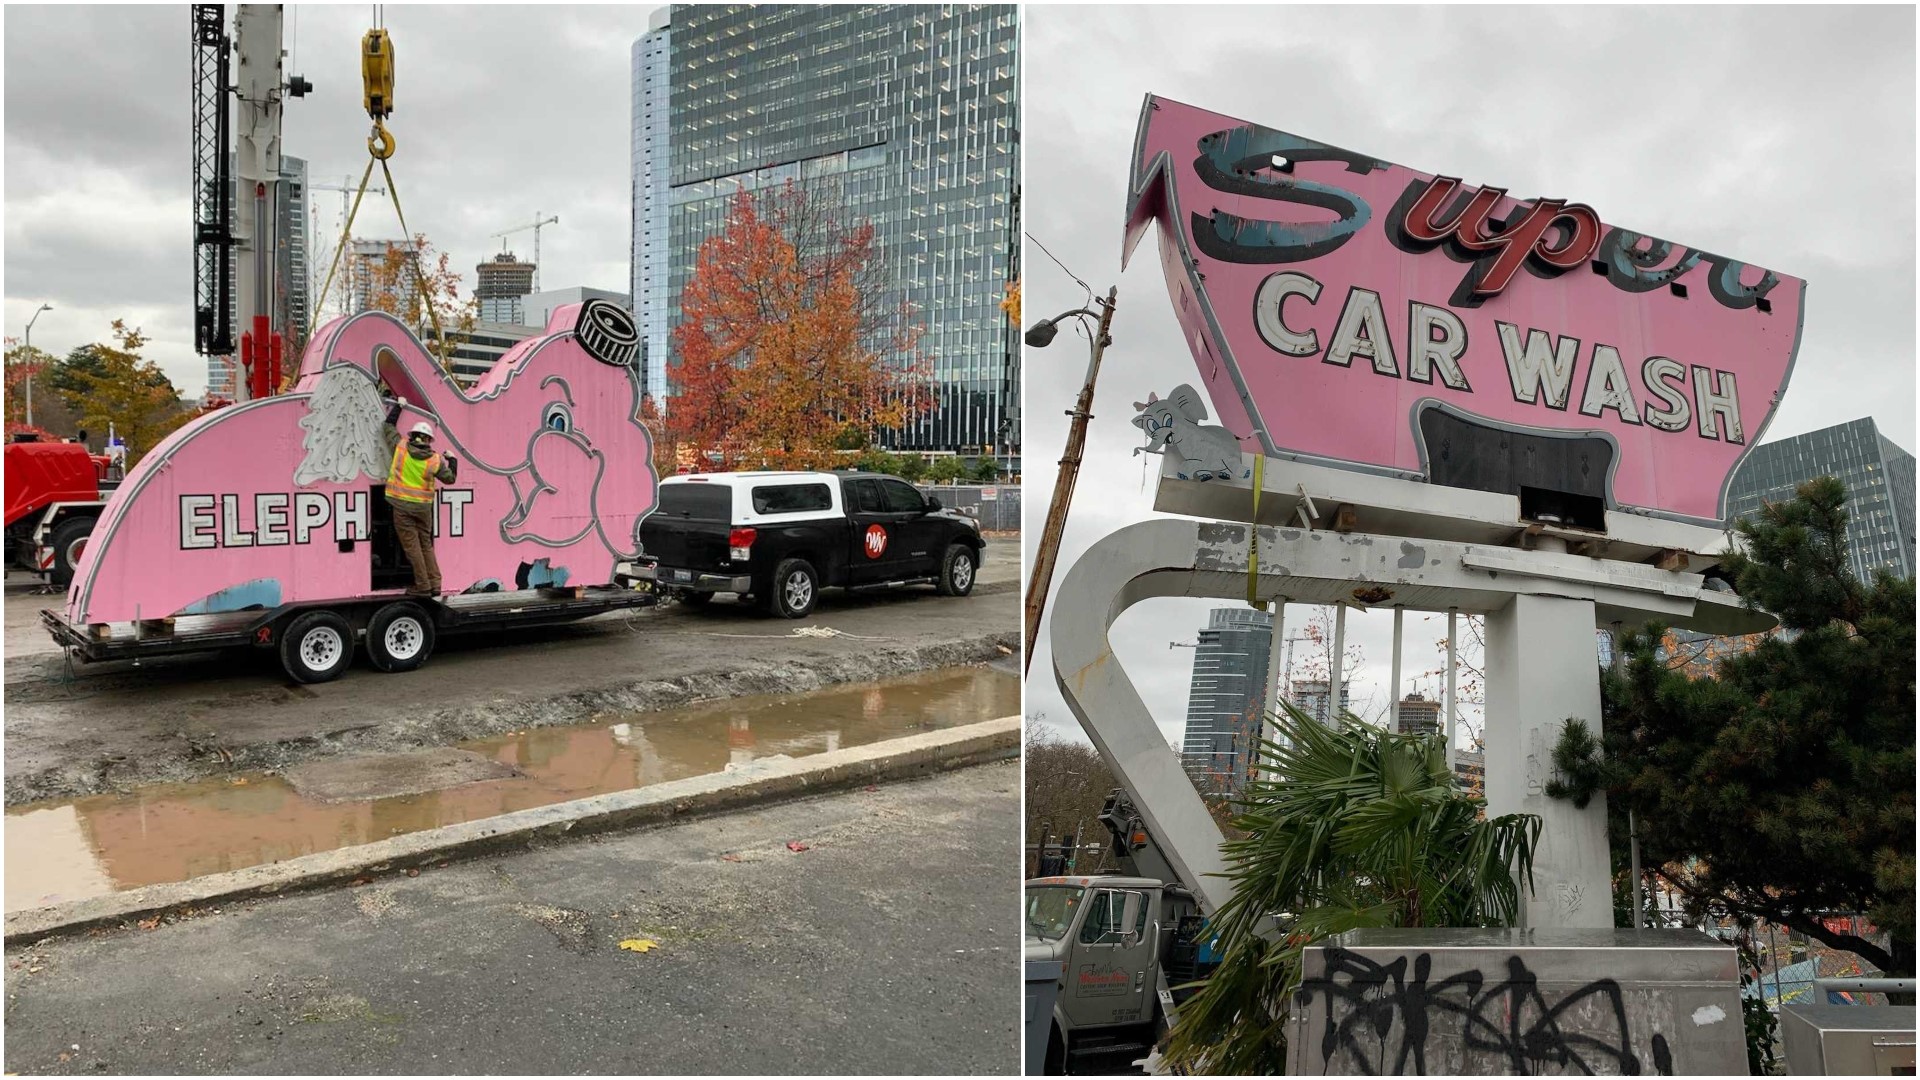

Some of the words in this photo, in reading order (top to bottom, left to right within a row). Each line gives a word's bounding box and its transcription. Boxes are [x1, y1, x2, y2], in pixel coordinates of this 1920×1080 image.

[1252, 271, 1474, 393] CAR
[1493, 320, 1745, 445] WASH
[179, 488, 474, 550] ELEPHT
